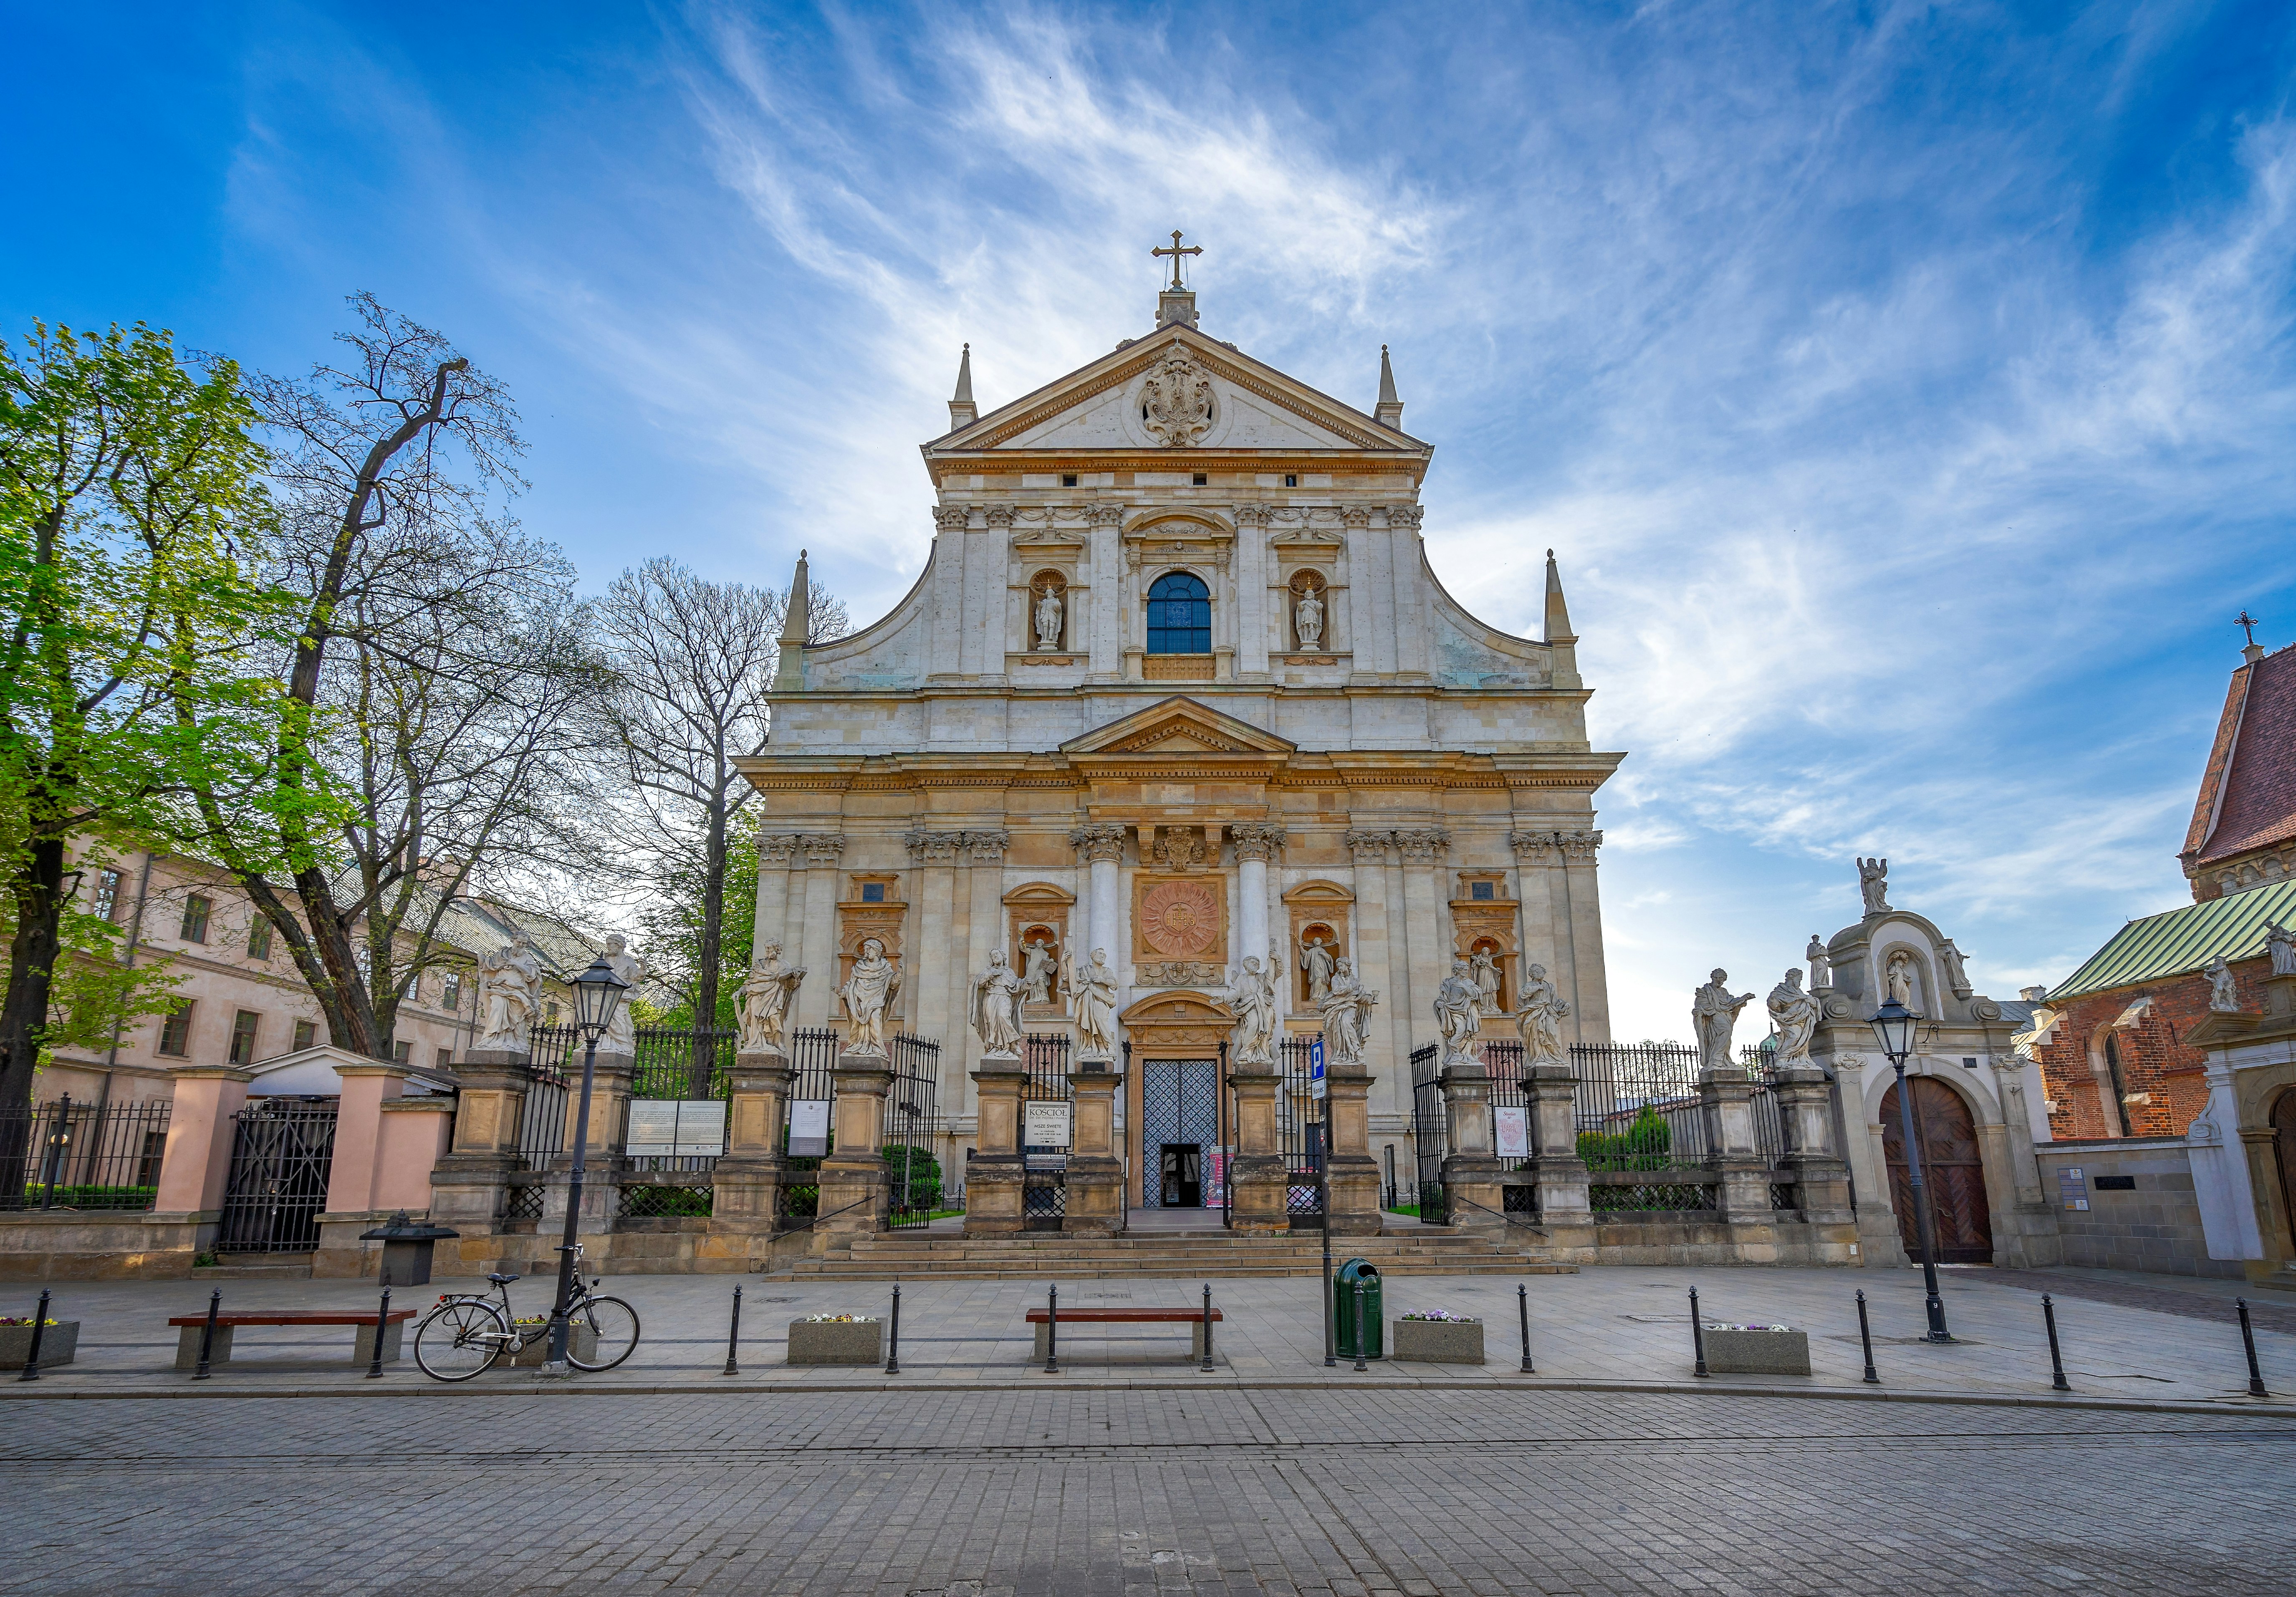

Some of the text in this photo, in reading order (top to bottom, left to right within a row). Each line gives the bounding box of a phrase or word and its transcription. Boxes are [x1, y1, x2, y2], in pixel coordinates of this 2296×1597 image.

[1313, 1046, 1321, 1076] P
[1313, 1086, 1324, 1094] Koniec
[1029, 1107, 1067, 1116] KOŚCIÓŁ
